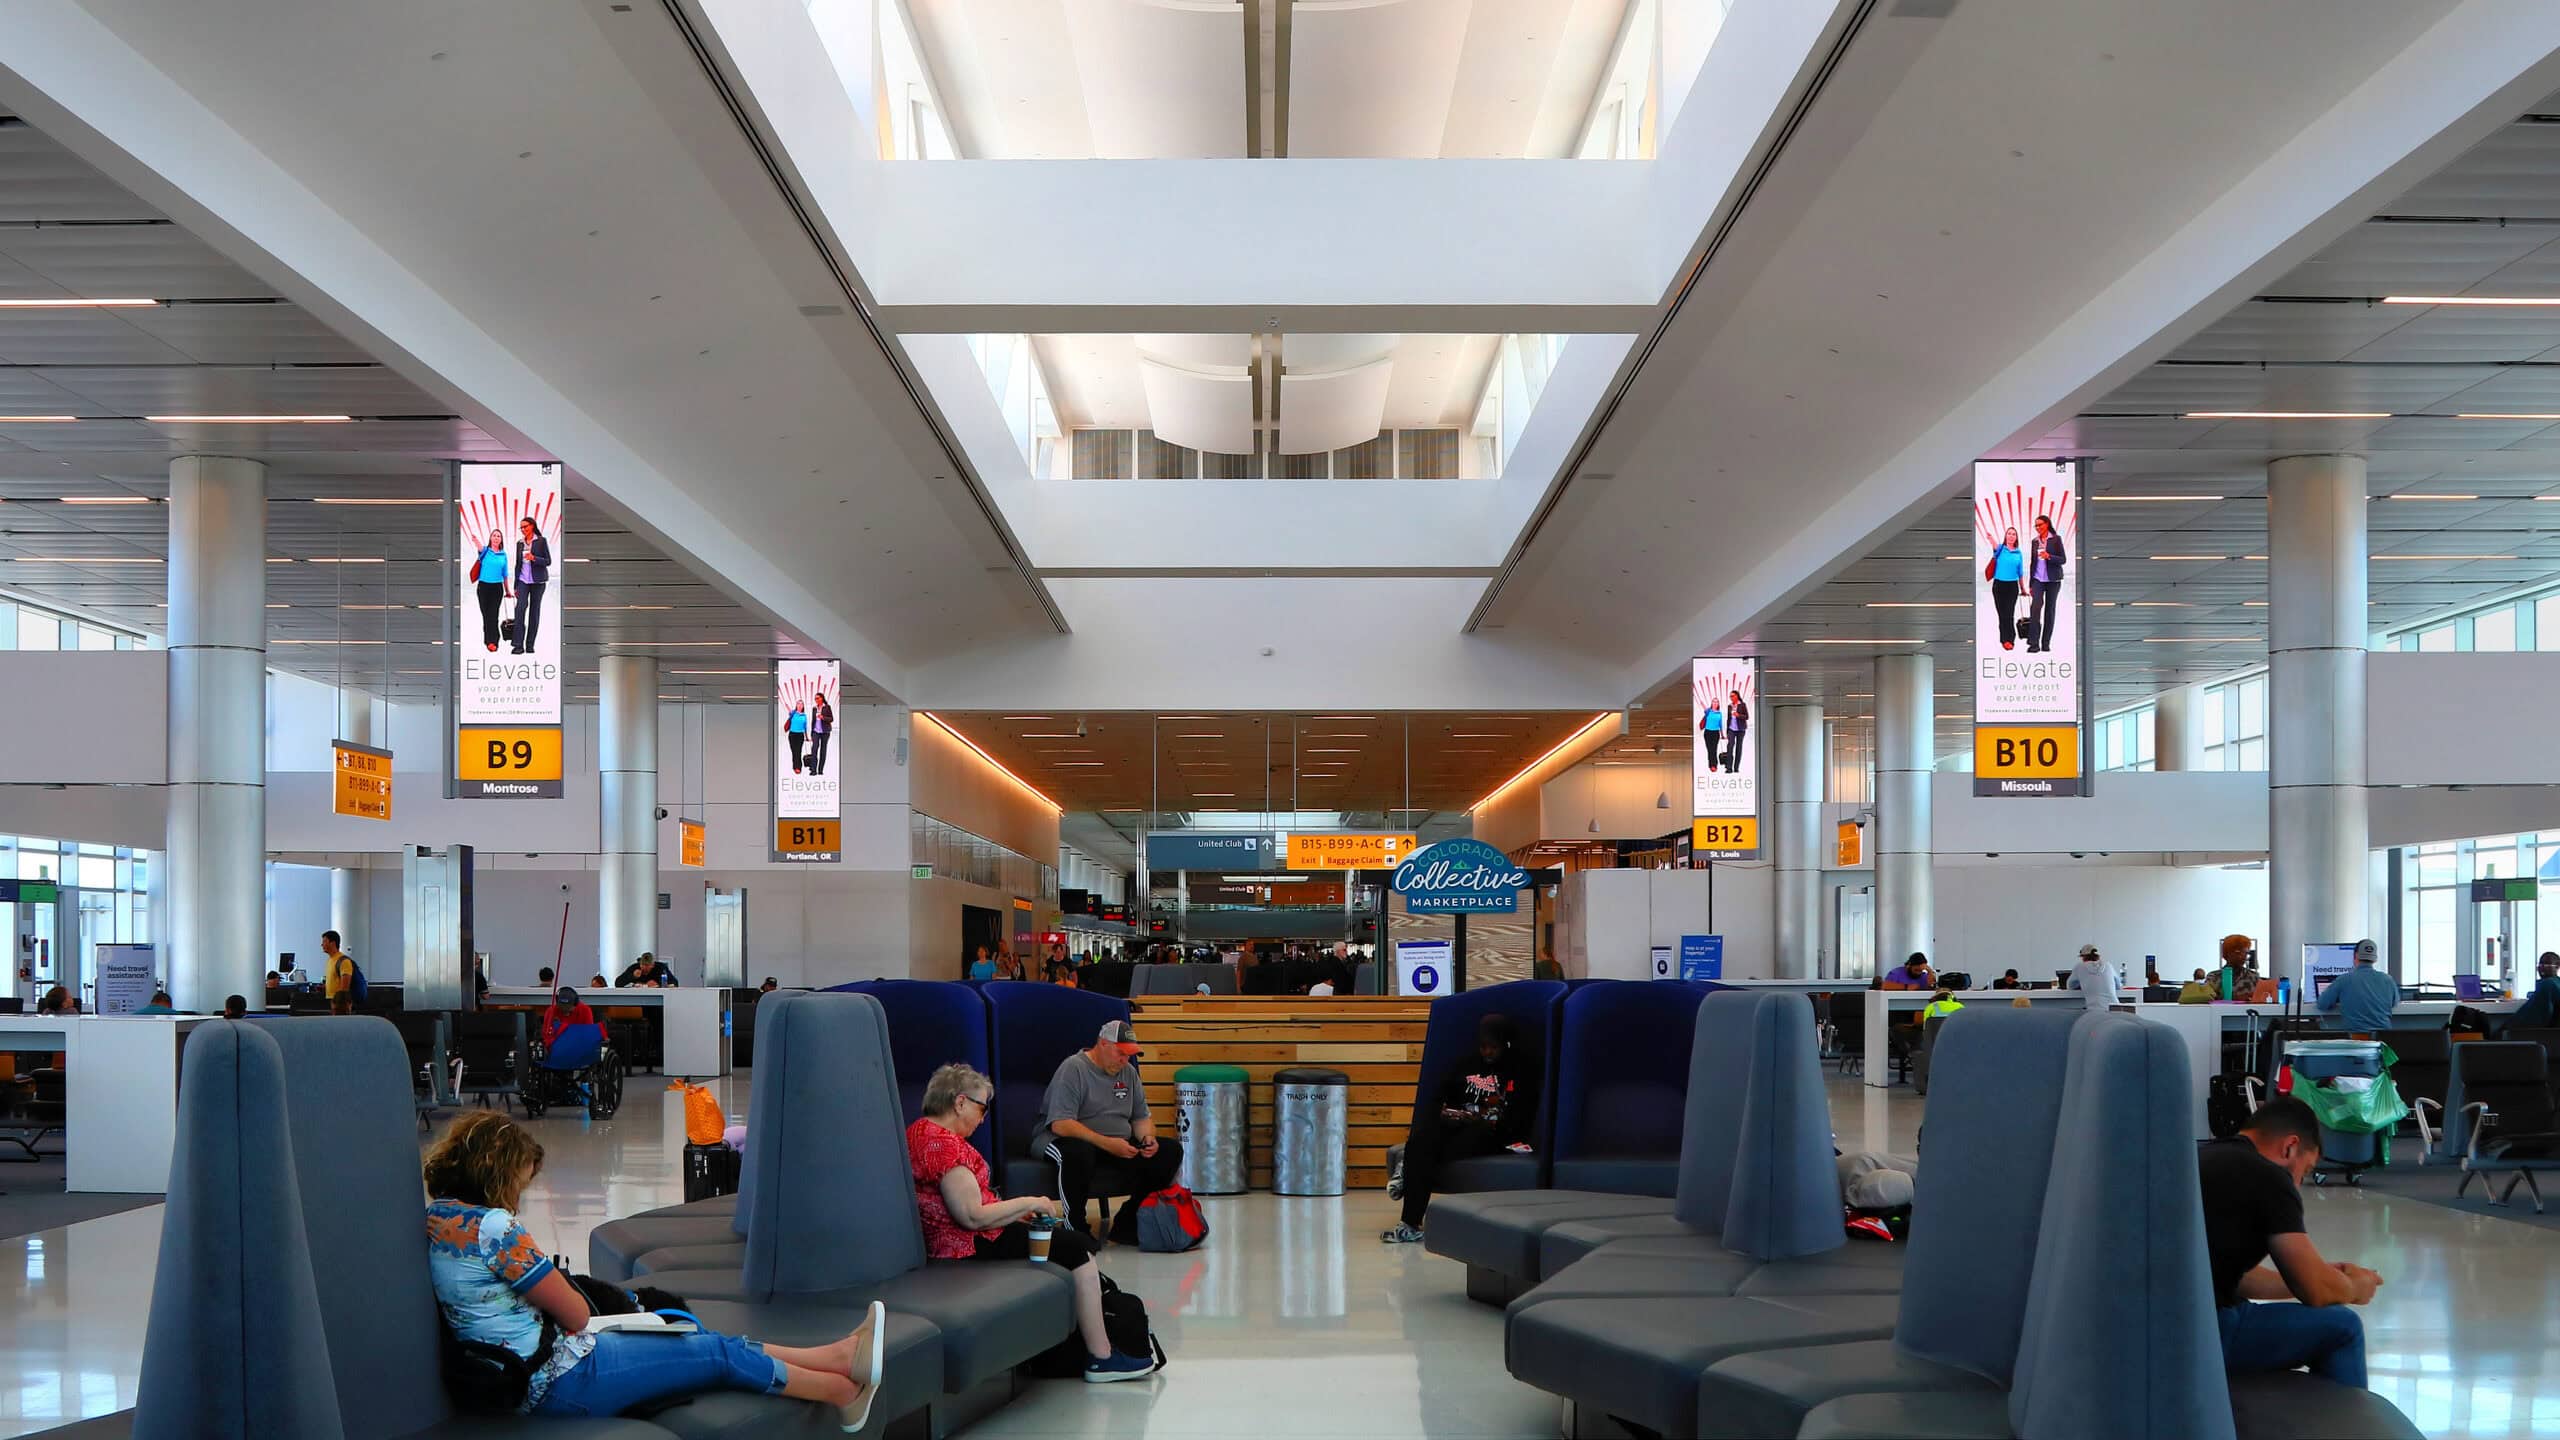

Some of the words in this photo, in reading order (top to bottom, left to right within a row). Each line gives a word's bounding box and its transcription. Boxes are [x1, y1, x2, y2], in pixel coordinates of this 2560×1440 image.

[466, 658, 556, 680] Elevate
[1982, 657, 2072, 679] Elevate
[478, 685, 501, 693] your
[506, 684, 544, 693] airport
[1993, 684, 2017, 692] your
[2021, 683, 2061, 692] airport
[480, 696, 542, 704] experience
[1996, 694, 2058, 703] experience
[487, 740, 533, 769] B9
[1996, 738, 2058, 767] B10
[482, 783, 539, 794] Montrose
[781, 778, 837, 792] Elevate
[1697, 776, 1753, 790] Elevate
[2001, 780, 2052, 792] Missoula
[792, 827, 825, 845] B11
[1706, 825, 1743, 843] B12
[1198, 839, 1224, 848] United
[1225, 839, 1242, 848] Club
[786, 853, 819, 861] Portland,
[1301, 856, 1316, 864] Exit
[1327, 856, 1360, 866] Baggage
[1361, 856, 1383, 864] Claim
[1418, 843, 1505, 867] COLORADO
[917, 868, 929, 878] EXIT
[1395, 860, 1528, 891] Collective
[1412, 897, 1513, 907] MARKETPLACE
